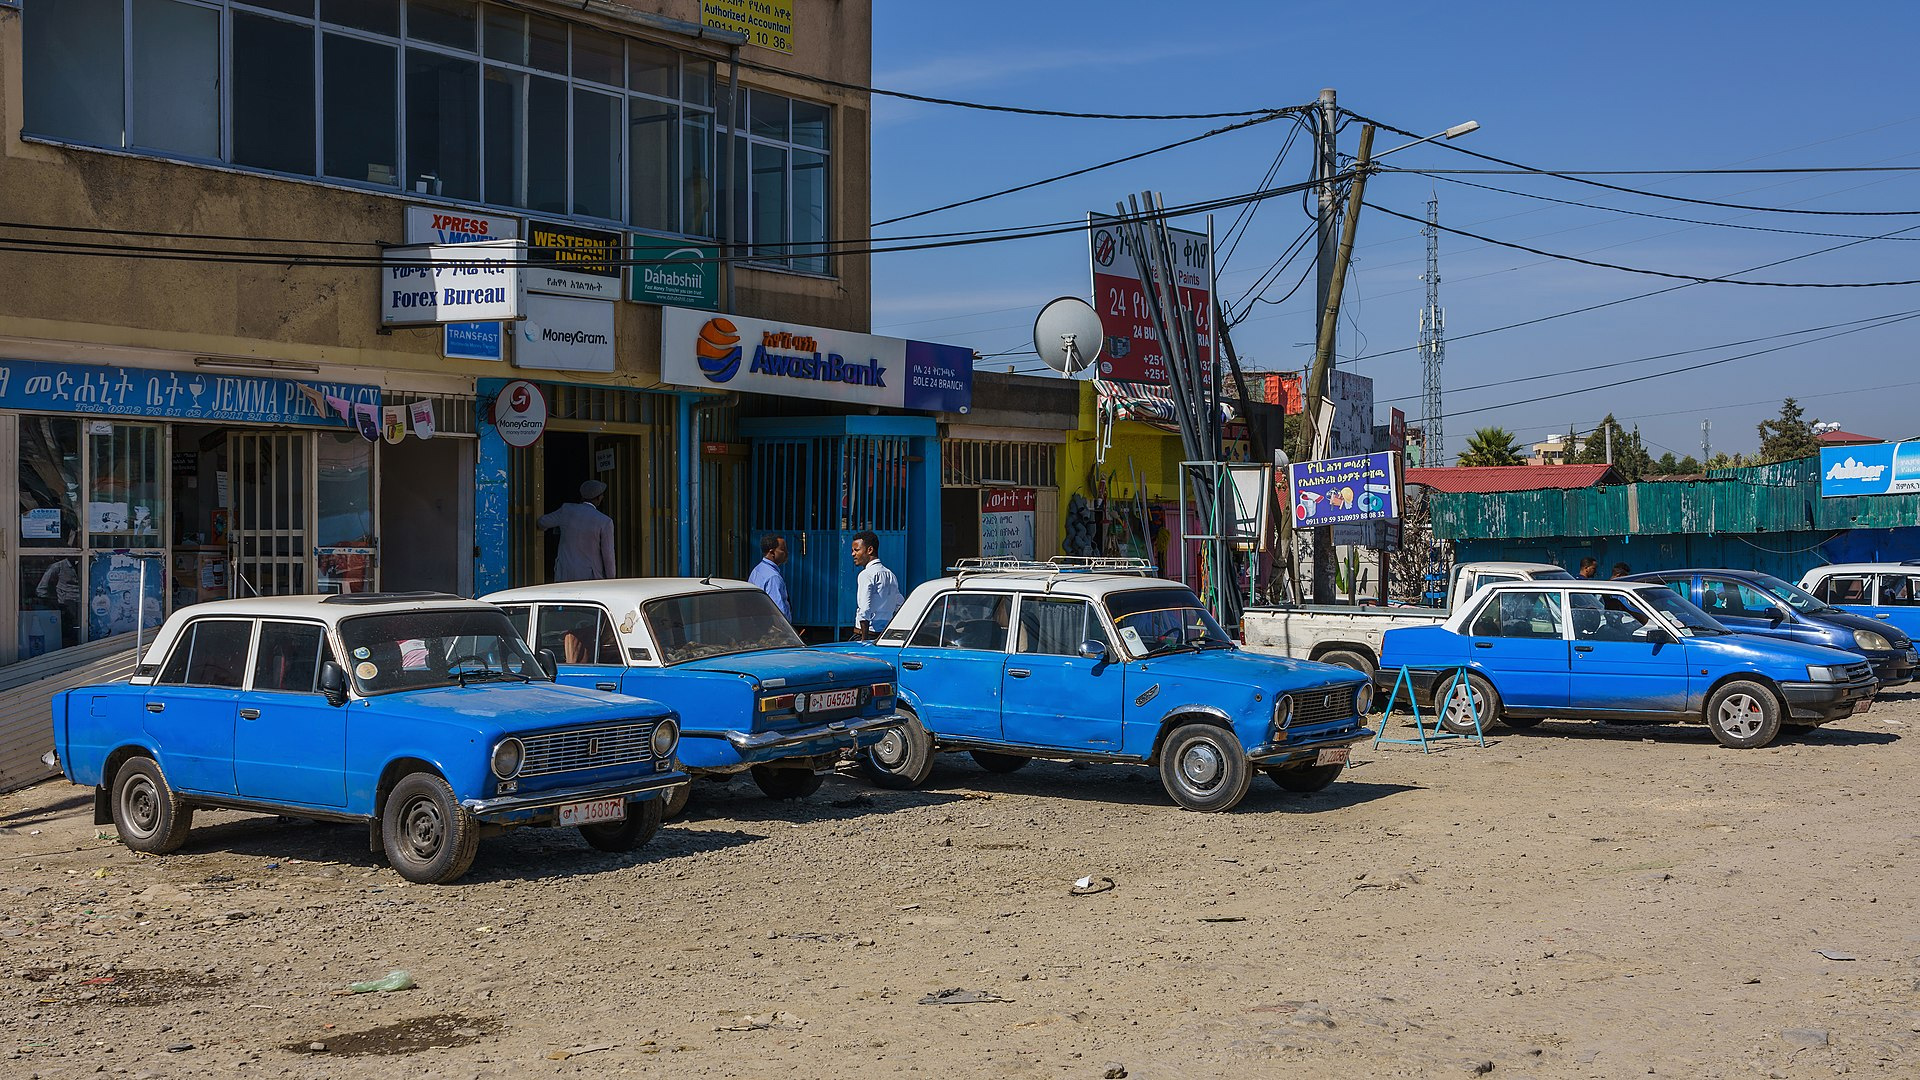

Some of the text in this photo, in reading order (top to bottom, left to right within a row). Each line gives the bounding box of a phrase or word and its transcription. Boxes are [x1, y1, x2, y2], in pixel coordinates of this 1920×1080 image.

[704, 3, 791, 34] Authorized Accountant
[756, 31, 768, 45] 10
[773, 36, 785, 49] 36
[431, 214, 488, 234] XPRESS
[534, 231, 603, 255] WESTERN
[555, 251, 603, 271] UNION
[644, 268, 702, 289] Dahabshiil
[1178, 269, 1200, 286] Paints
[392, 287, 506, 308] Forex Bureau
[1109, 288, 1126, 317] 24
[448, 329, 498, 343] TRANSFAST
[542, 328, 608, 346] MoneyGram.
[1133, 325, 1143, 339] 24
[749, 344, 887, 388] AwashBank
[923, 366, 931, 375] 24
[913, 376, 964, 391] BOLE 24 BRANCH
[212, 377, 278, 414] JEMMA
[108, 405, 142, 415] 0912
[499, 420, 543, 429] MoneyGram
[826, 692, 851, 708] 04525
[585, 801, 617, 820] 16887
